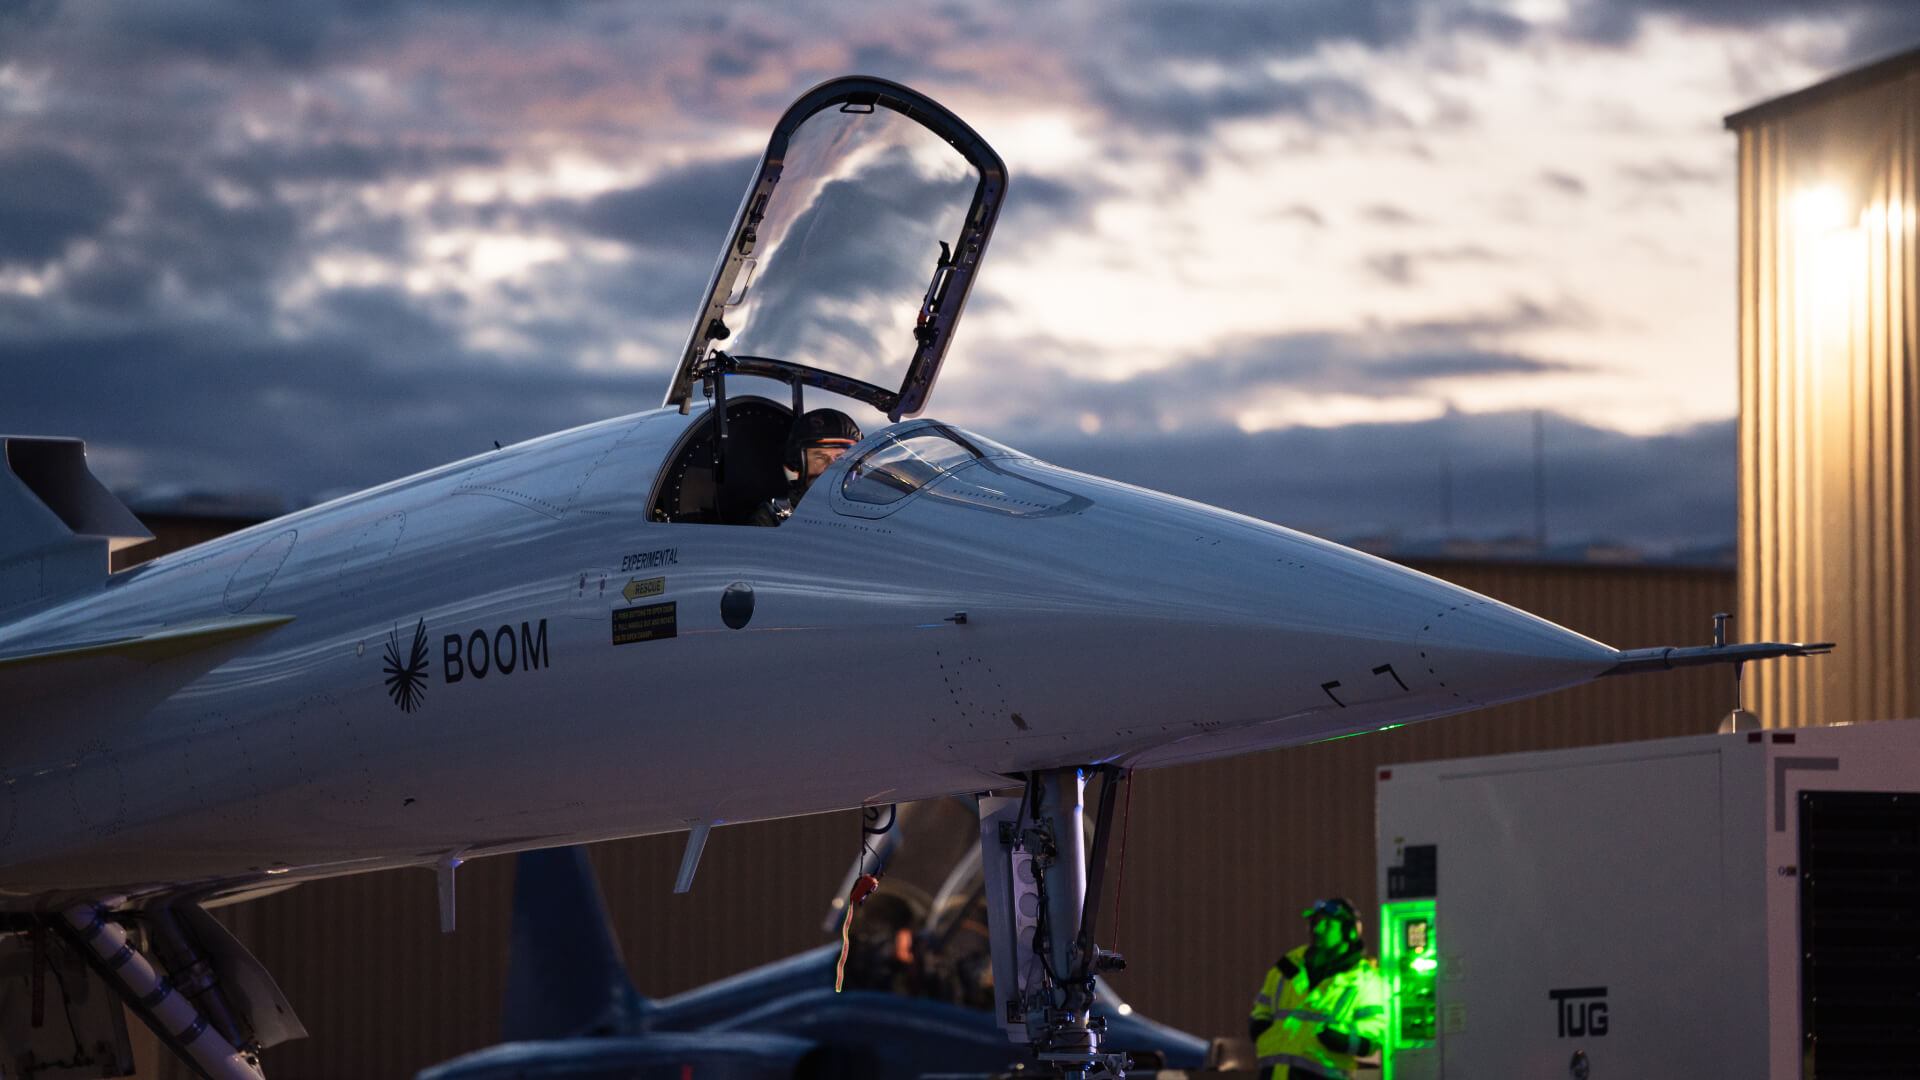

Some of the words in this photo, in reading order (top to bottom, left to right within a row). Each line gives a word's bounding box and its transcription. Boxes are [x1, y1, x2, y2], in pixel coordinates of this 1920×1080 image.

[621, 547, 678, 572] EXPERIMENTAL
[635, 581, 661, 594] RESCUE
[443, 618, 549, 683] BOOM
[1549, 987, 1608, 1037] TUG
